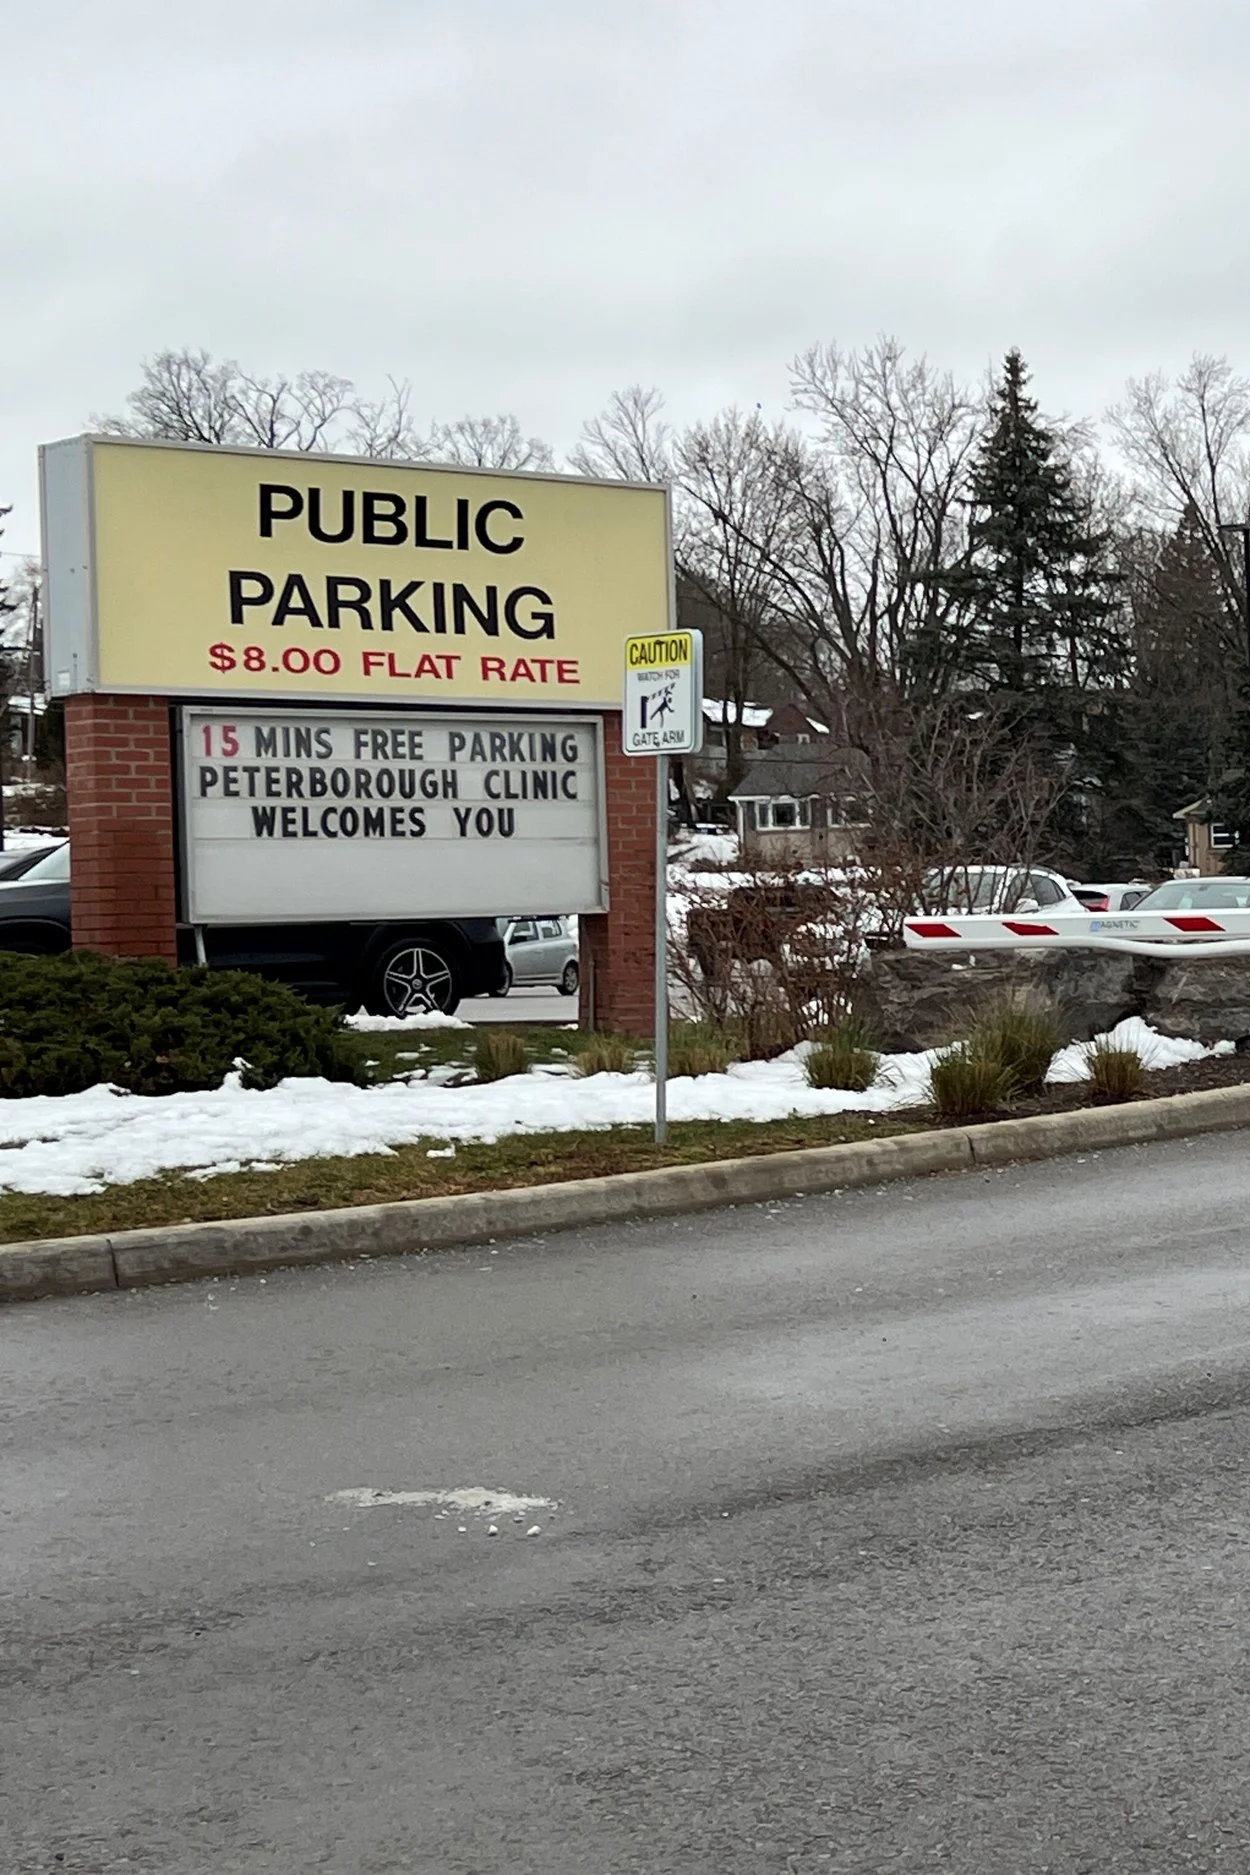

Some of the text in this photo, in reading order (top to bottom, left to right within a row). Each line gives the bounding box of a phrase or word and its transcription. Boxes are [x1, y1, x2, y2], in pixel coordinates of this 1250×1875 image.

[259, 483, 525, 555] PUBLIC
[228, 570, 556, 640] PARKING
[209, 642, 580, 684] $8.00 FLAT RATE
[629, 638, 688, 666] CAUTION
[637, 669, 681, 682] WATCH FOR
[202, 724, 579, 763] 15 MINS FREE PARKING
[632, 730, 686, 746] GATE ARM
[199, 765, 578, 801] PETERBOROUGH CLINIC
[251, 805, 516, 839] WELCOMES YOU
